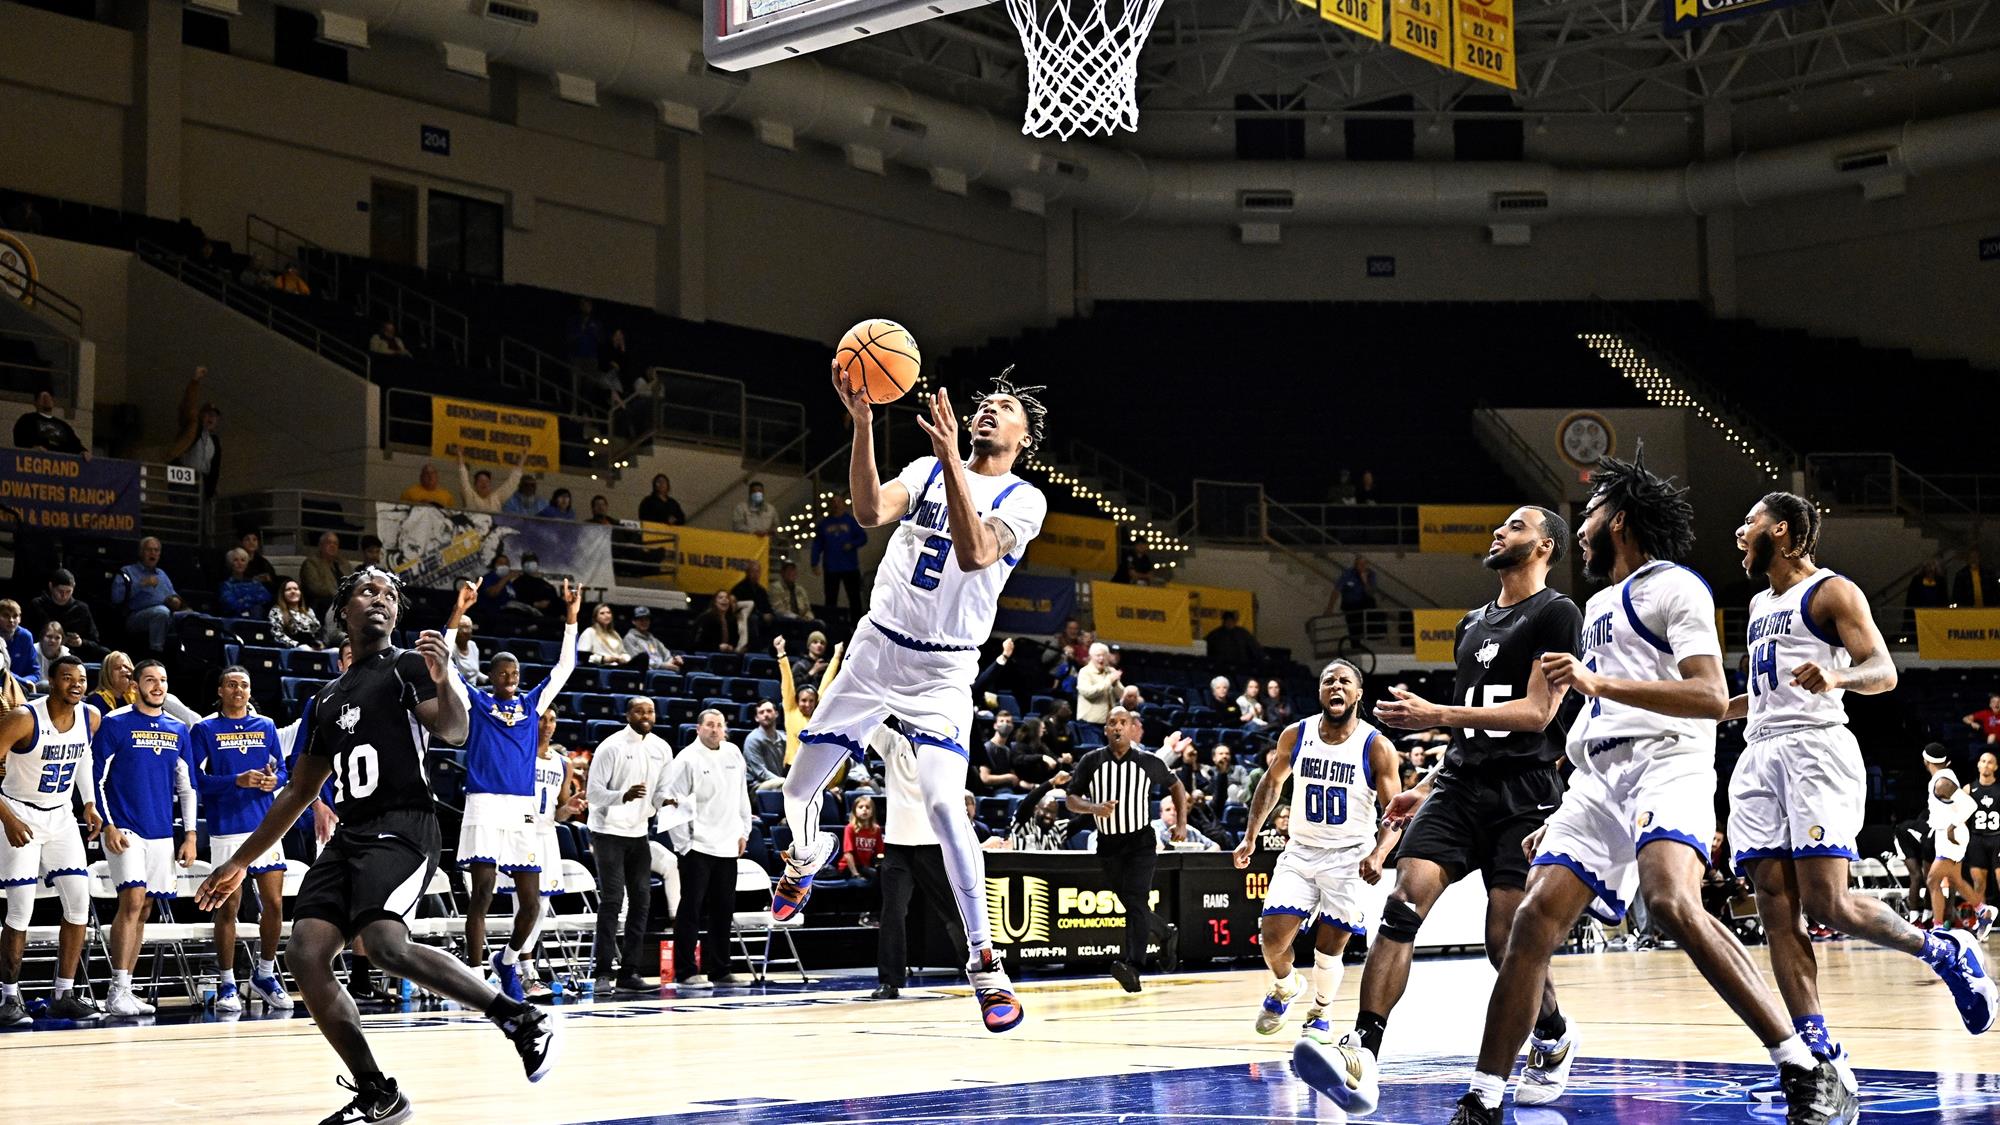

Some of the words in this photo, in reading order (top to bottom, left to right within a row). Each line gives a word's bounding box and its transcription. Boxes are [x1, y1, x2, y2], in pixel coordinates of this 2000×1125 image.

[1336, 0, 1368, 22] 2018
[1406, 20, 1437, 49] 2019
[1467, 44, 1502, 71] 2020
[424, 132, 447, 149] 204
[446, 404, 498, 423] BERKSHIRE
[500, 413, 546, 429] HATHAWAY
[460, 427, 486, 441] HOME
[489, 430, 531, 447] SERVICES
[16, 456, 79, 477] LEGRAND
[170, 469, 192, 481] 103
[0, 480, 65, 503] DWATERS
[69, 486, 115, 506] RANCH
[41, 510, 69, 529] BOB
[74, 513, 134, 531] LEGRAND
[910, 534, 953, 592] 2
[1766, 609, 1794, 636] STATE
[1948, 629, 1985, 641] FRANKE
[1751, 640, 1778, 697] 14
[1464, 684, 1513, 740] 15
[132, 731, 159, 740] ANGELO
[160, 732, 178, 742] STATE
[136, 738, 177, 748] BASKETBALL
[216, 734, 244, 742] ANGELO
[245, 732, 265, 740] STATE
[220, 739, 264, 747] BASKETBALL
[41, 744, 66, 761] ANGELO
[66, 742, 85, 760] STATE
[37, 762, 76, 794] 22
[333, 743, 379, 803] 10
[1300, 757, 1329, 780] ANGELO
[1330, 761, 1356, 785] STATE
[1305, 783, 1348, 825] 00
[1974, 810, 2000, 831] 23
[1263, 835, 1286, 848] POSS
[1203, 893, 1230, 908] RAMS
[1057, 917, 1127, 929] COMMUNICATIONS
[1207, 919, 1231, 945] 75
[1020, 948, 1067, 959] KWFR-FM
[1077, 945, 1121, 956] KCLL-FM
